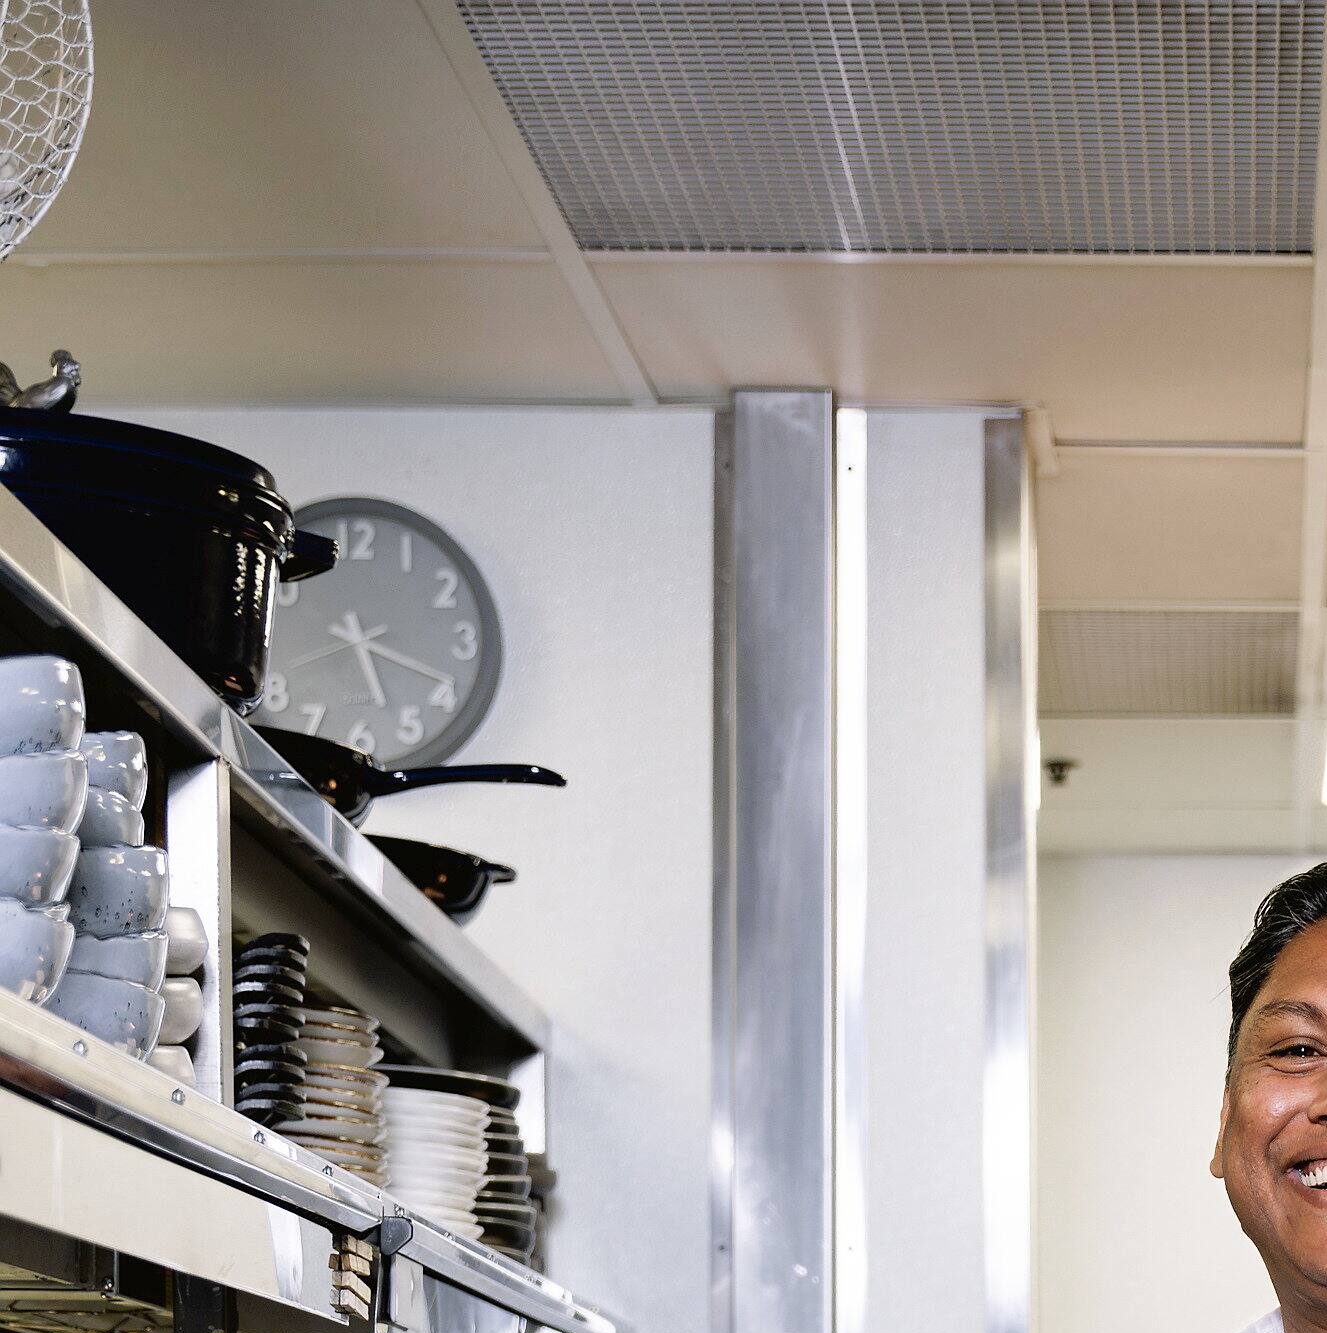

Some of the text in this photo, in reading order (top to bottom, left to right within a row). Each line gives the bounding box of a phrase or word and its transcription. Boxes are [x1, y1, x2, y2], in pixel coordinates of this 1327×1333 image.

[338, 520, 376, 561] 12
[401, 531, 412, 573] 1
[432, 568, 459, 609] 2
[452, 620, 478, 661] 3
[264, 672, 289, 712] 8
[430, 679, 457, 713] 4
[300, 702, 327, 736] 7
[348, 720, 376, 753] 6
[398, 704, 425, 746] 5
